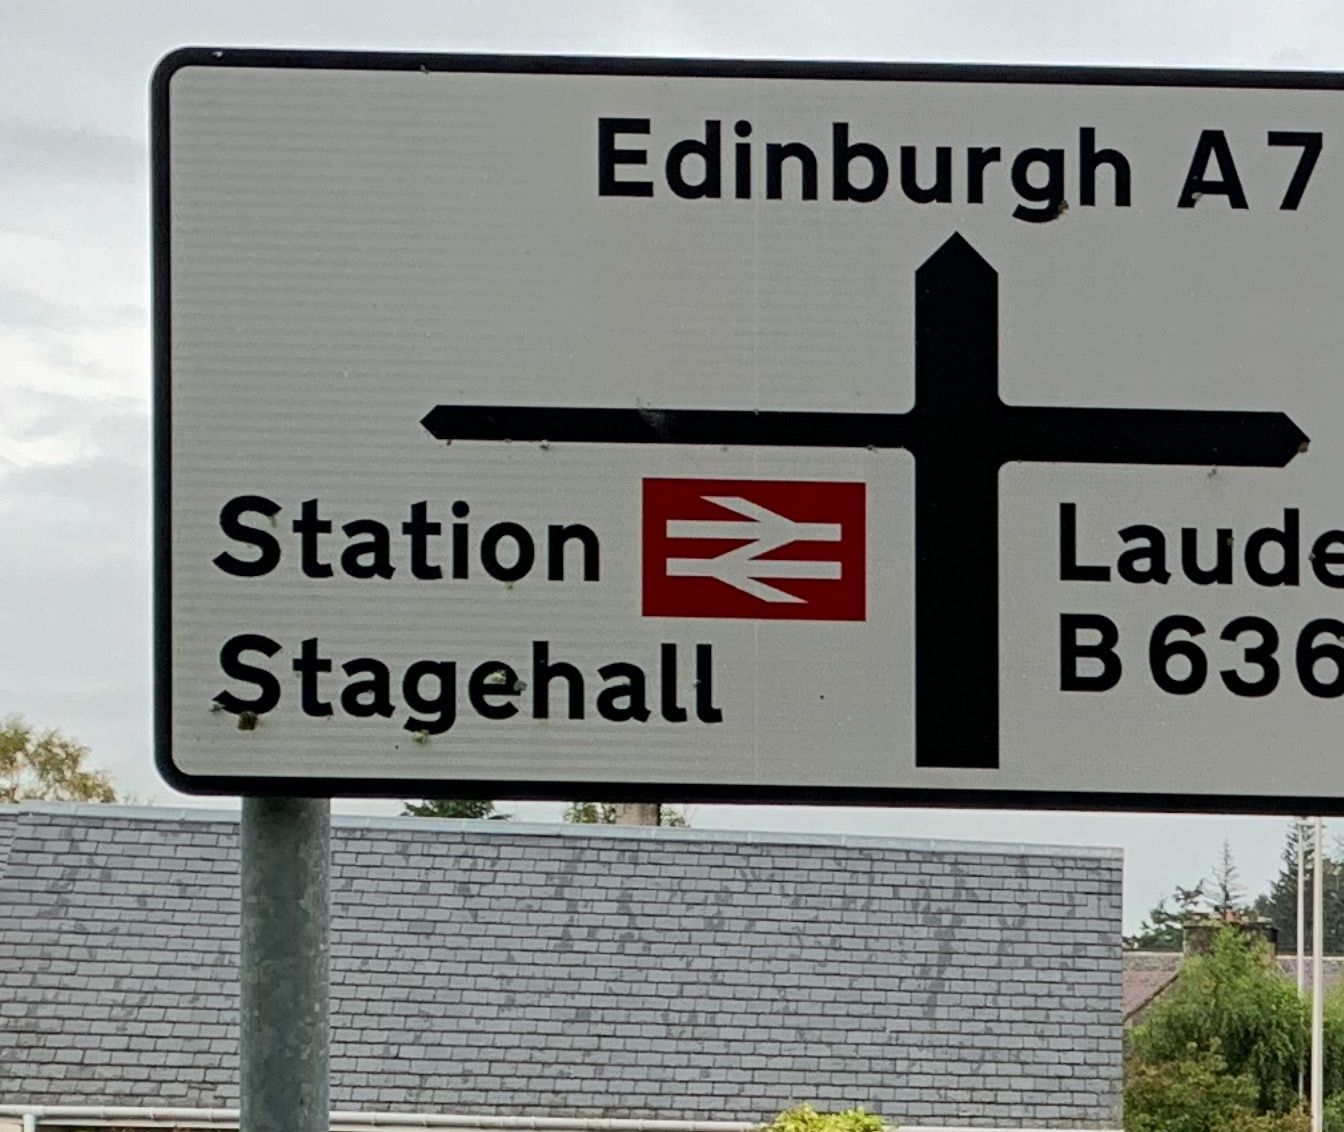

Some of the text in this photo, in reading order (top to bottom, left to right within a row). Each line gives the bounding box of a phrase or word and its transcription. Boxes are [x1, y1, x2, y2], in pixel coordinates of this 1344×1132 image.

[598, 117, 1132, 223] Edinburgh
[212, 494, 600, 583] Station
[210, 633, 724, 737] Stagehall
